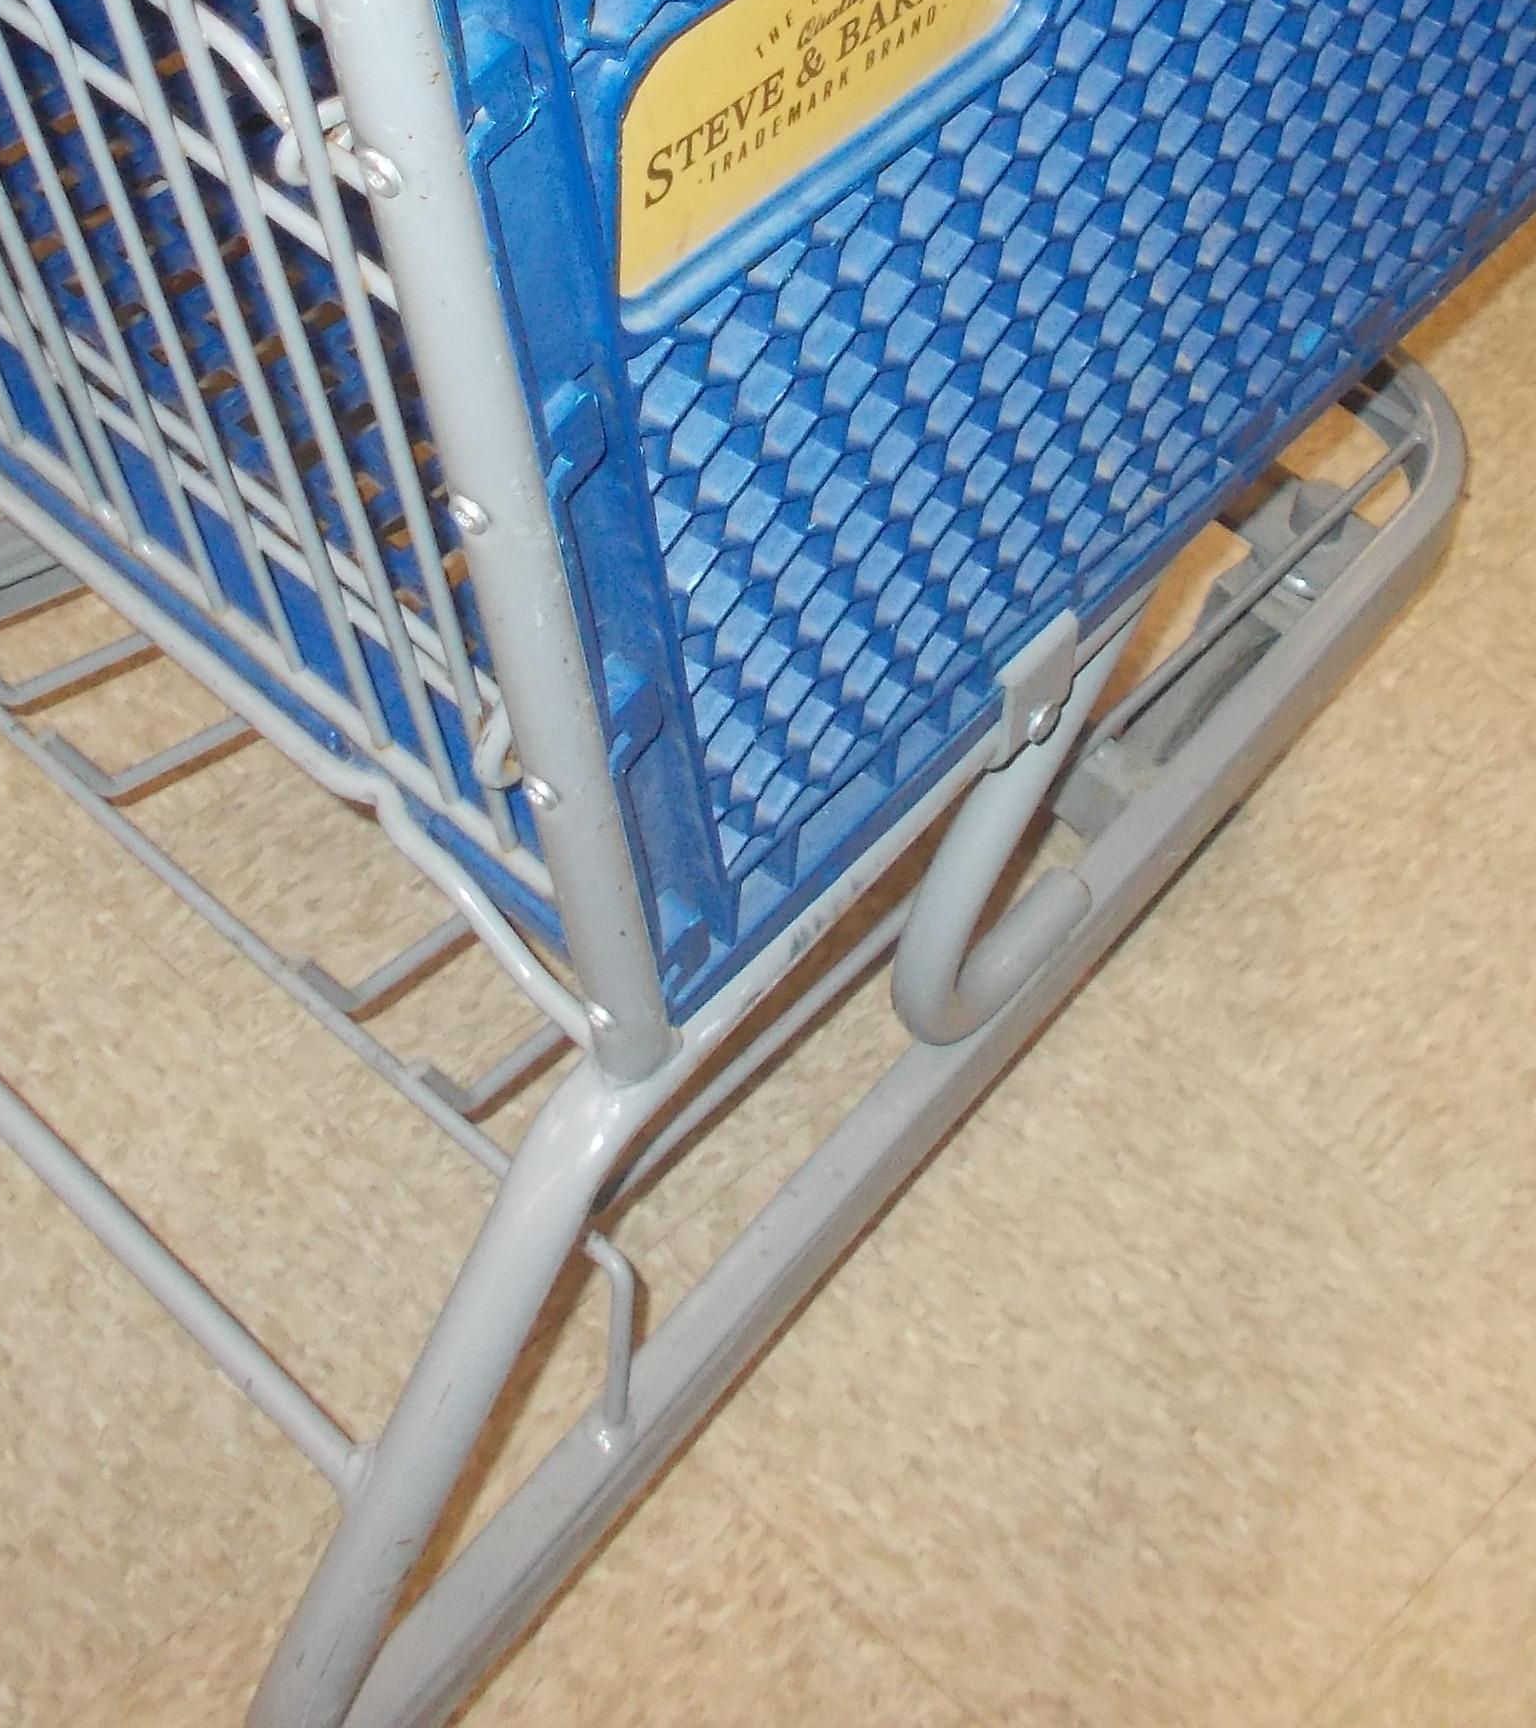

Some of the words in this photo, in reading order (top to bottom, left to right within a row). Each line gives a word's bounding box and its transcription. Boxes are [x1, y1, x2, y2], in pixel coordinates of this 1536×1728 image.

[754, 8, 793, 60] THE
[643, 66, 785, 210] STEVE
[795, 45, 826, 89] &
